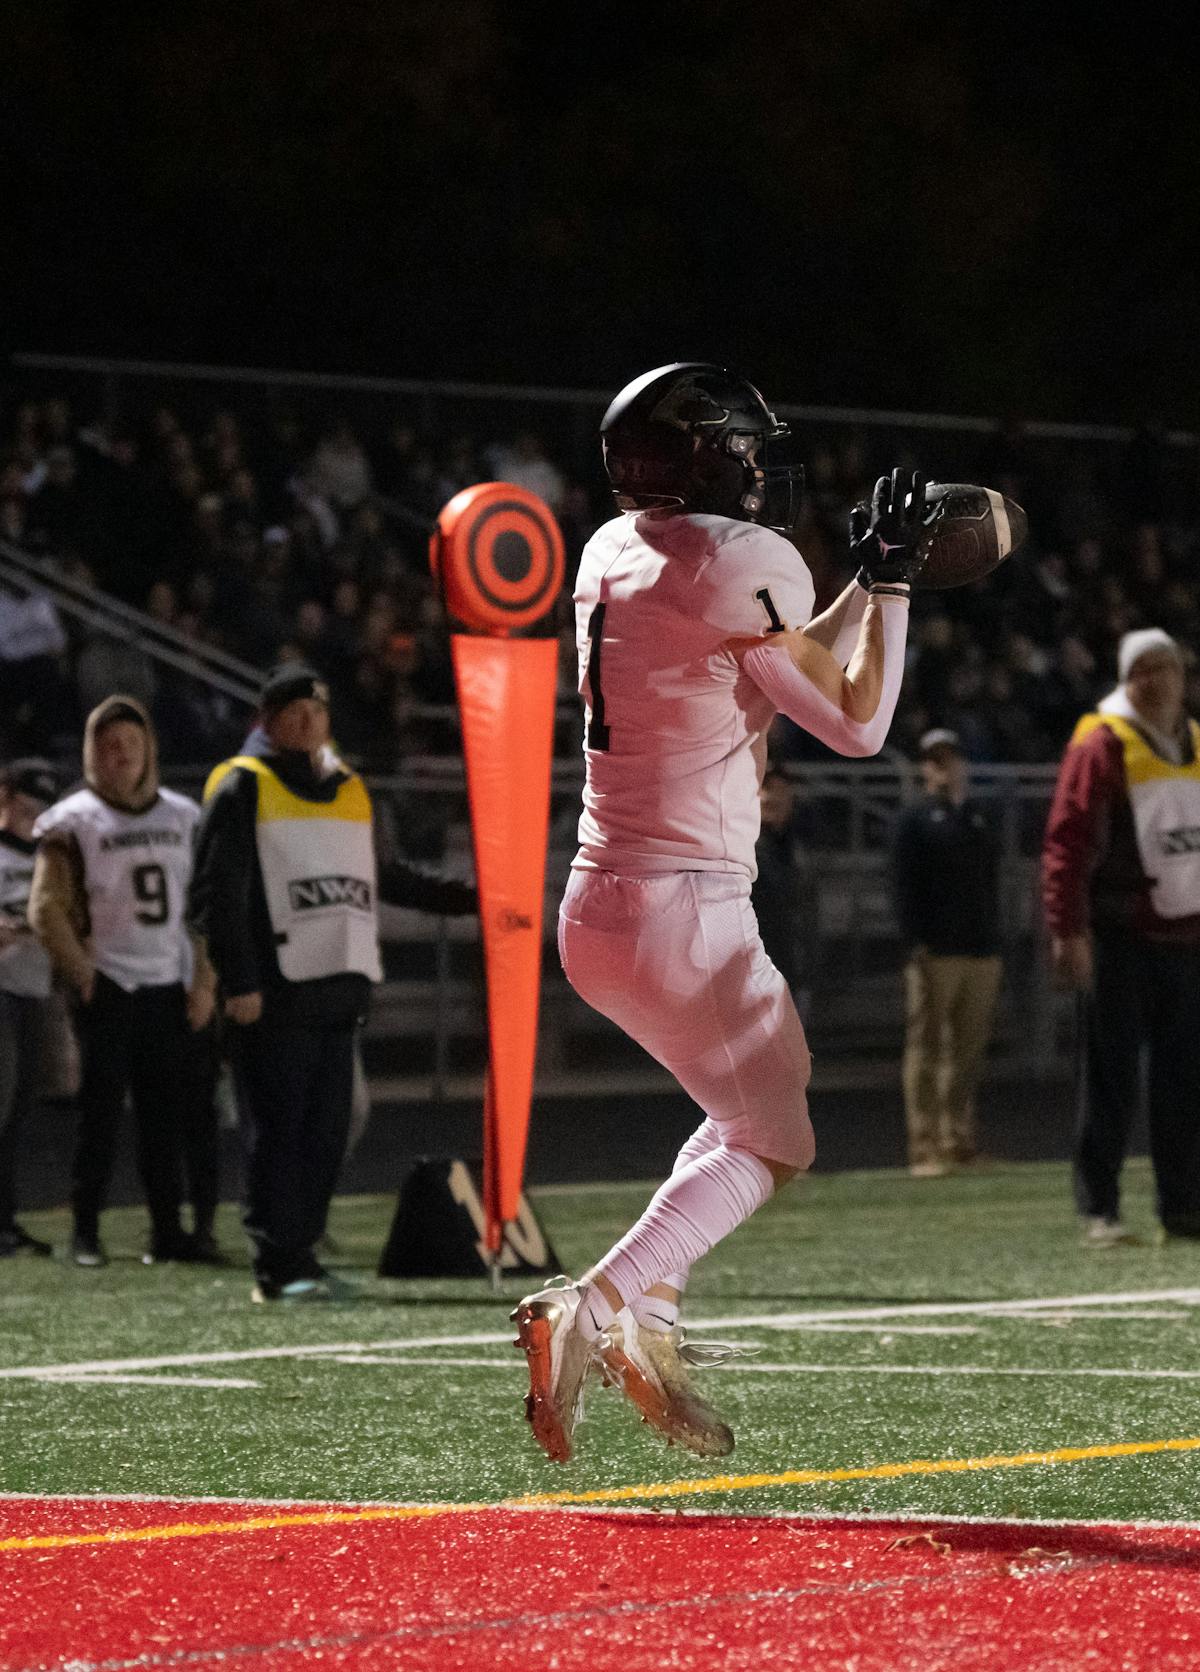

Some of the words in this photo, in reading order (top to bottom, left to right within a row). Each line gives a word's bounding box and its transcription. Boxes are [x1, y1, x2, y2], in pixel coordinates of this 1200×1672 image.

[756, 588, 786, 633] 1
[588, 602, 610, 752] 1
[131, 864, 169, 926] 9
